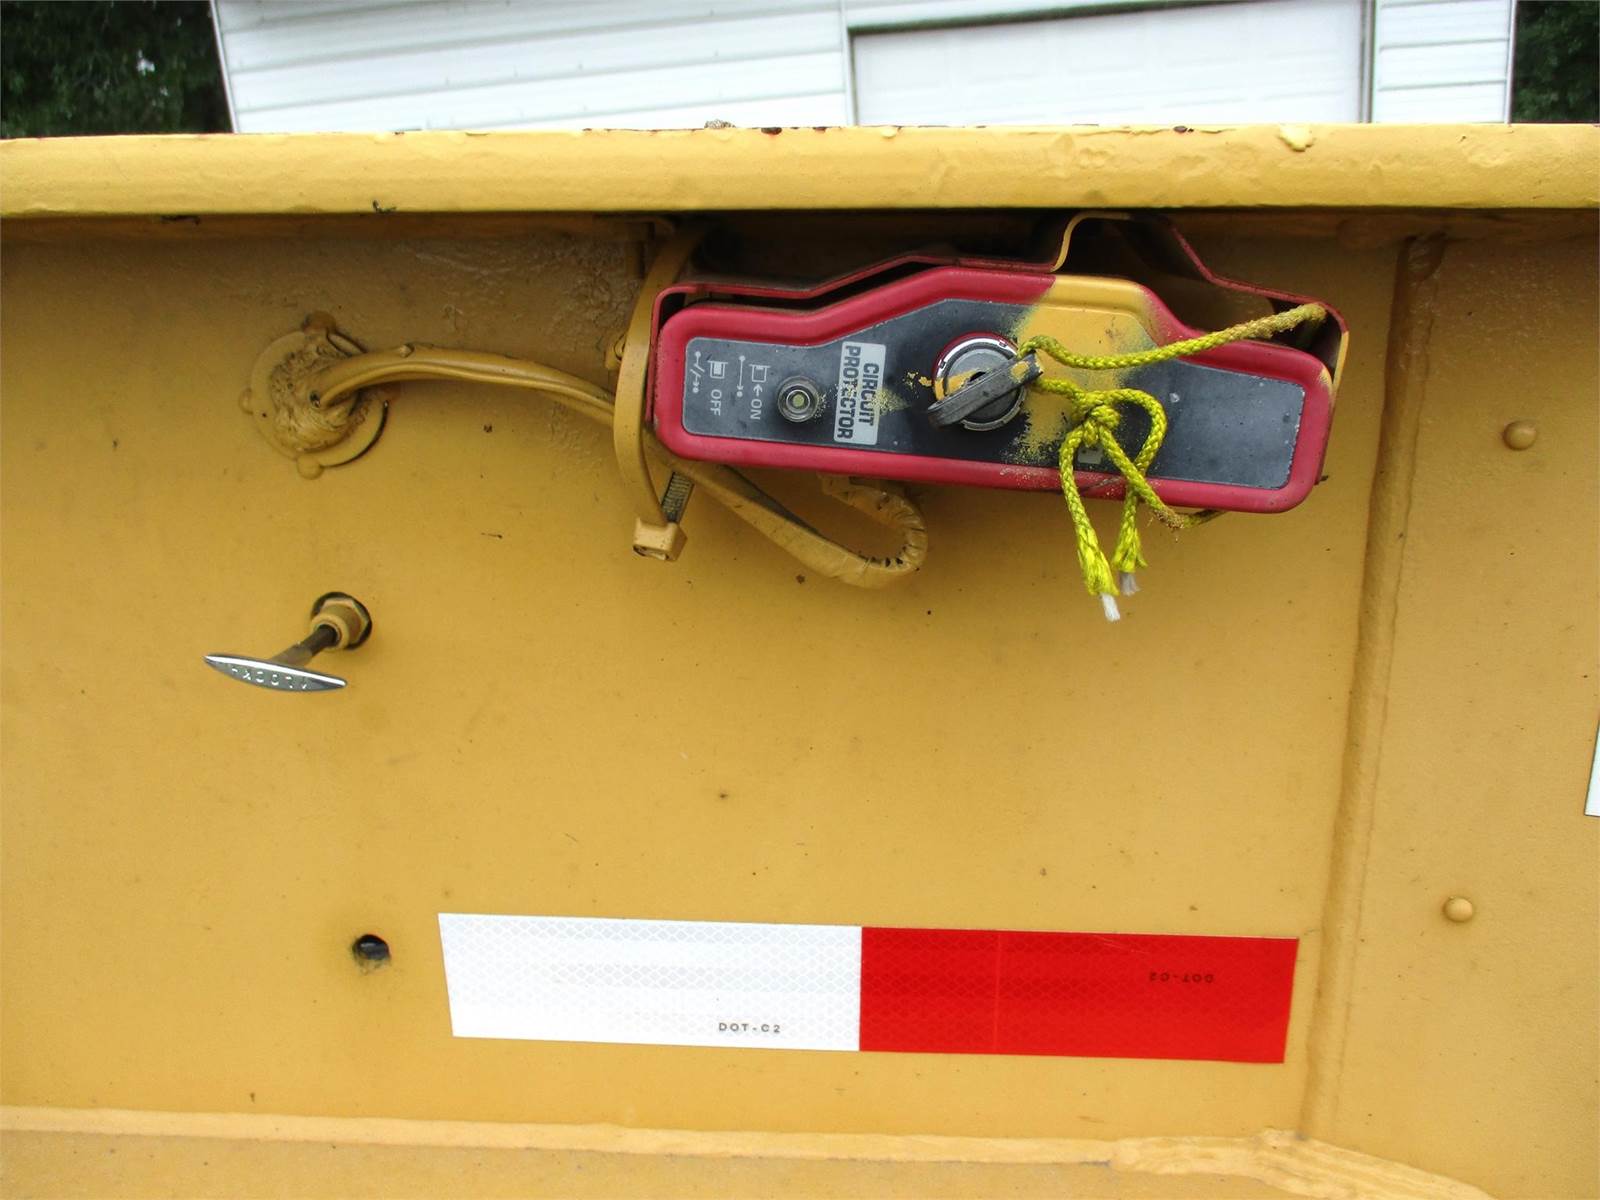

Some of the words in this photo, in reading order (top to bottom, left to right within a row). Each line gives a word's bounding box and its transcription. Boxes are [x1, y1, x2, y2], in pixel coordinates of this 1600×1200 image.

[710, 388, 722, 416] OFF
[837, 345, 861, 439] PROTECTOR
[858, 362, 879, 426] CIRCUIT
[750, 398, 763, 420] ON
[719, 1022, 780, 1033] DOT-C2
